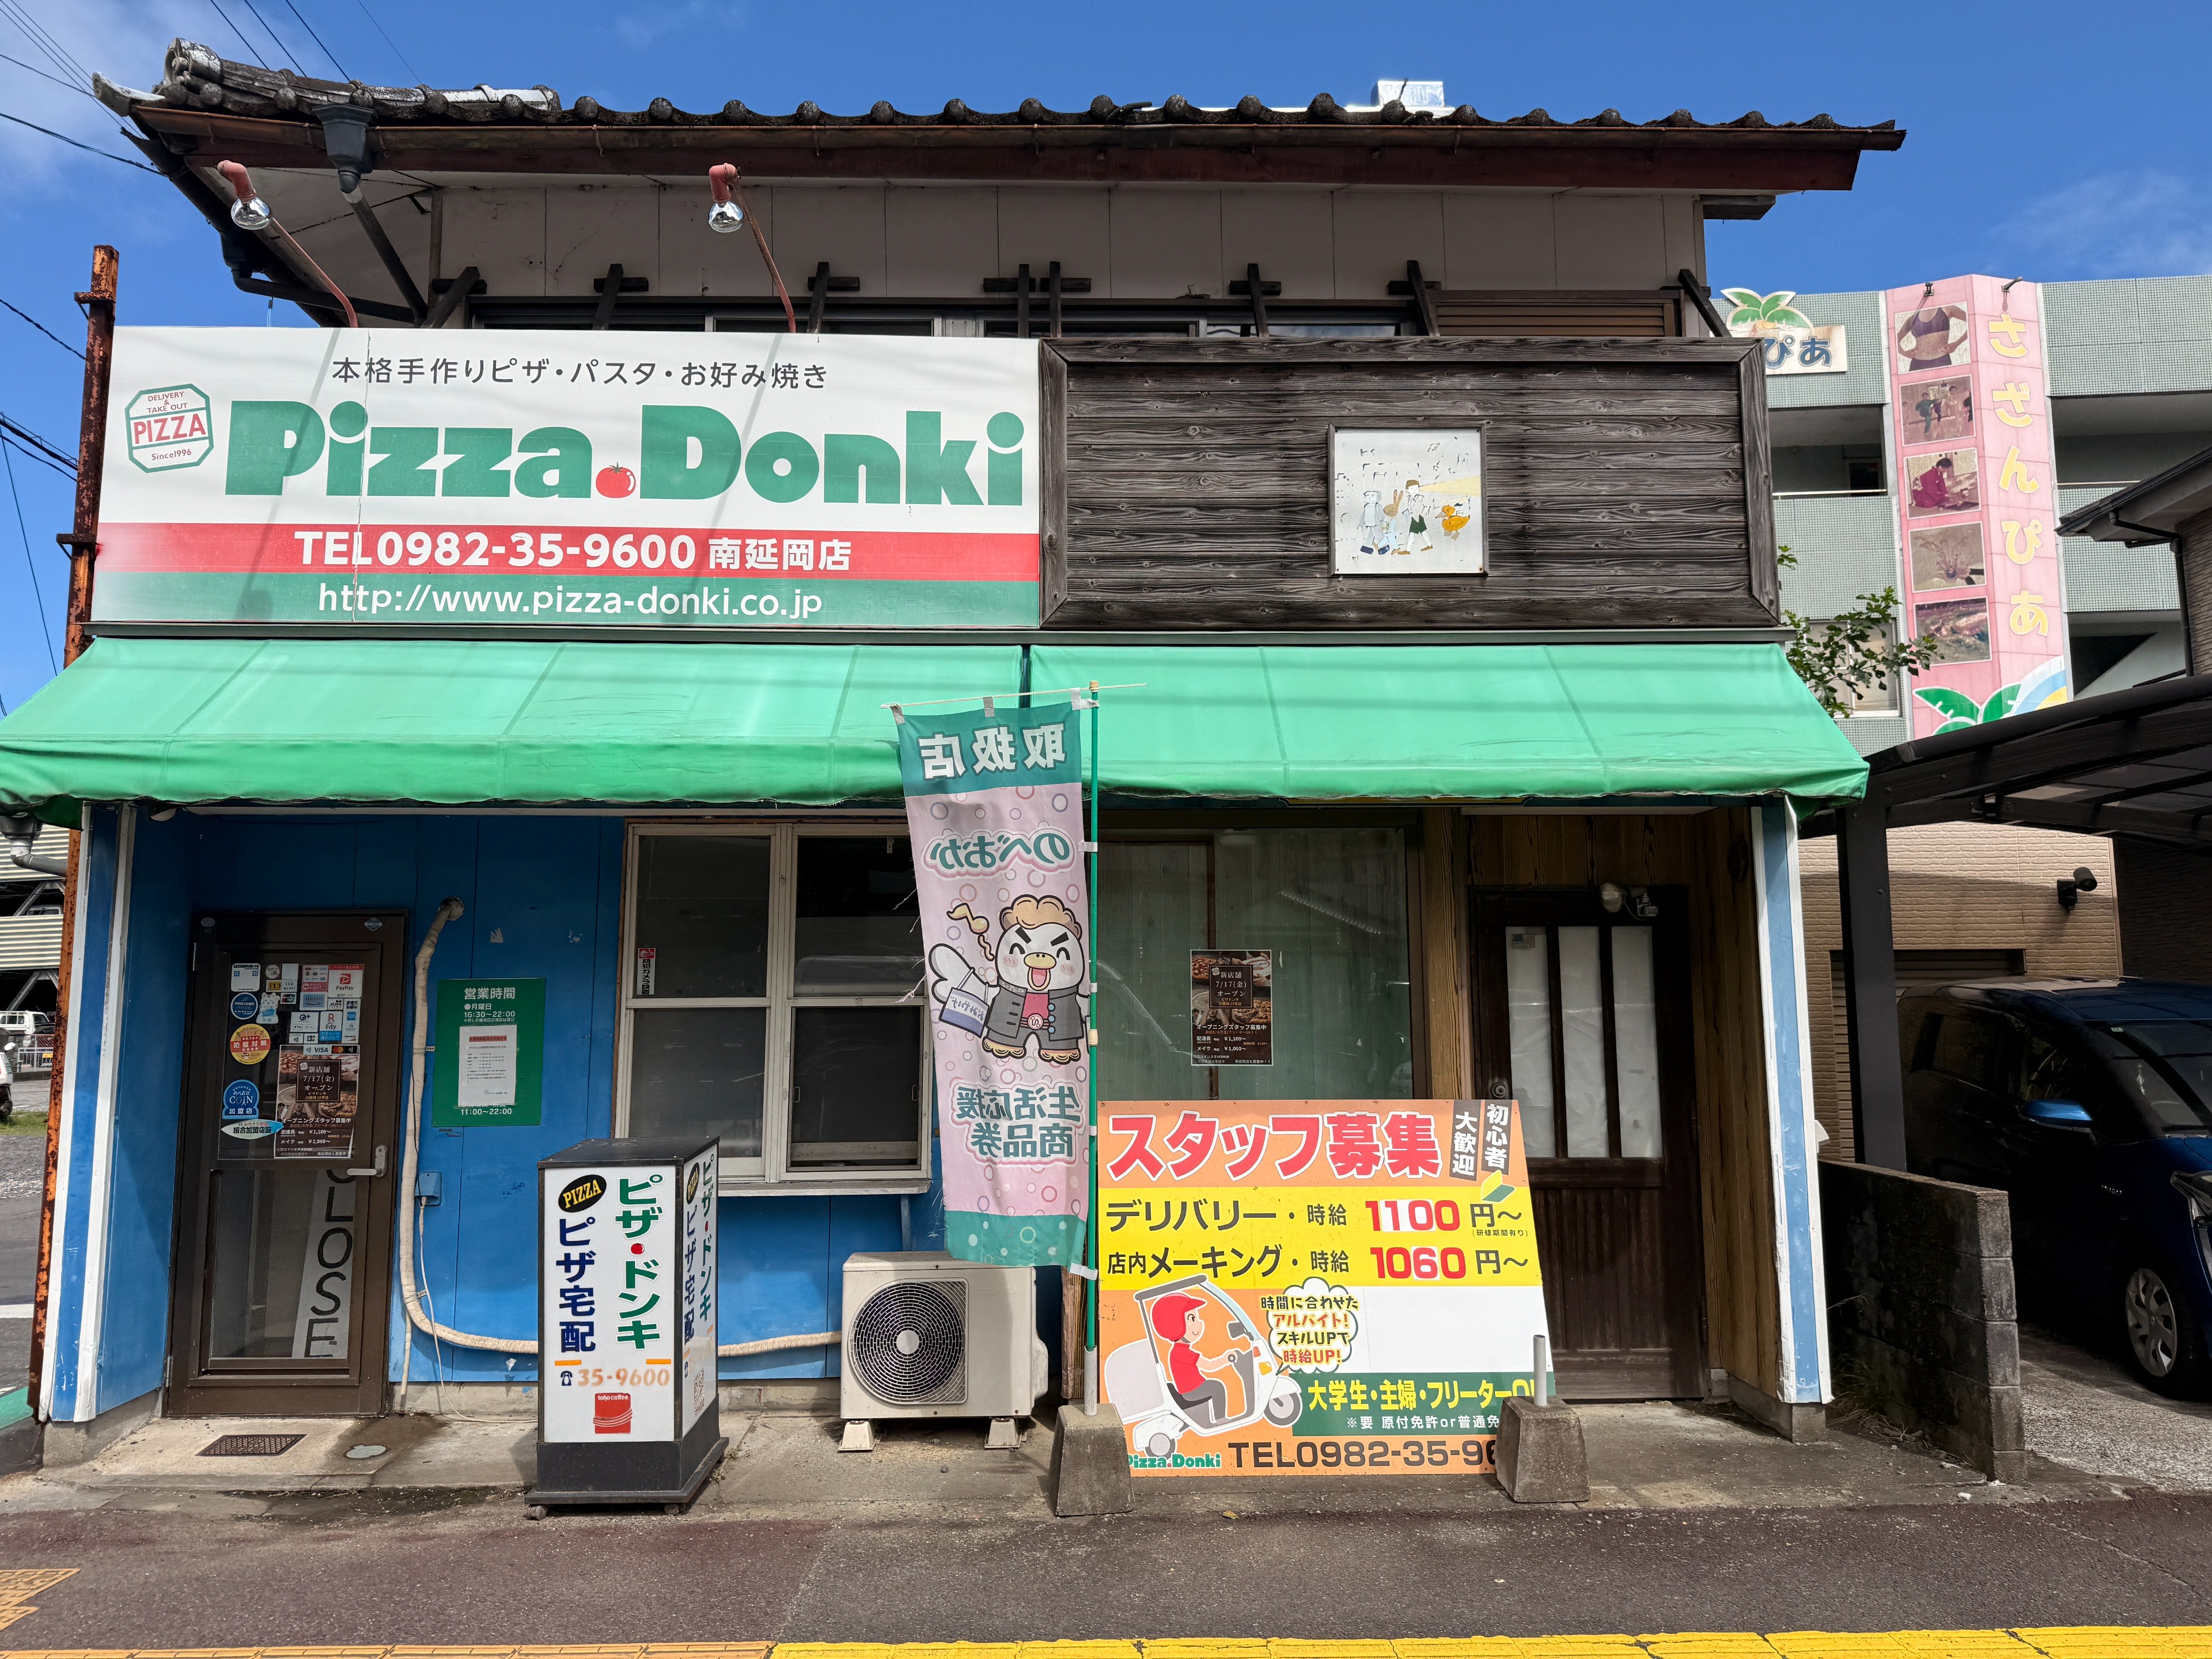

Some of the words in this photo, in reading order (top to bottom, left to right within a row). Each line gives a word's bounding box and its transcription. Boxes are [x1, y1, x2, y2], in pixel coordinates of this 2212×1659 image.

[332, 357, 828, 389] 本格手作りピザ・パスタ・お好み焼き
[147, 391, 184, 402] DELIVERY
[147, 406, 168, 414] TAKE
[133, 413, 206, 444] PIZZA
[151, 448, 192, 461] Since1996
[1987, 313, 2049, 638] さざんぴあ
[294, 531, 696, 569] TEL0982-35-9600
[709, 537, 851, 571] 南延岡店
[319, 583, 822, 620] http://www.pizza-donki.co.jp
[464, 987, 516, 1000] 営業時間
[1107, 1110, 1442, 1181] スタッフ募集
[1452, 1111, 1478, 1177] 大歓迎
[1484, 1103, 1509, 1171] 初心者
[562, 1179, 603, 1210] PIZZA
[687, 1168, 699, 1200] PIZZA
[1106, 1198, 1347, 1232] デリバリー・時給
[1365, 1199, 1460, 1232] 1100
[684, 1205, 698, 1346] ピザ宅配
[1107, 1244, 1350, 1278] 店内メーキング・時給
[1370, 1246, 1467, 1280] 1060
[556, 1216, 596, 1353] ピザ宅配
[1260, 1294, 1359, 1312] 時間に合わせた
[1272, 1311, 1350, 1330] アルバイト!
[1276, 1330, 1352, 1346] スキルUPで
[1282, 1347, 1342, 1365] 時給UP!
[577, 1368, 670, 1387] 35-9600
[1307, 1378, 1535, 1412] 大学生・主婦・フリーターO
